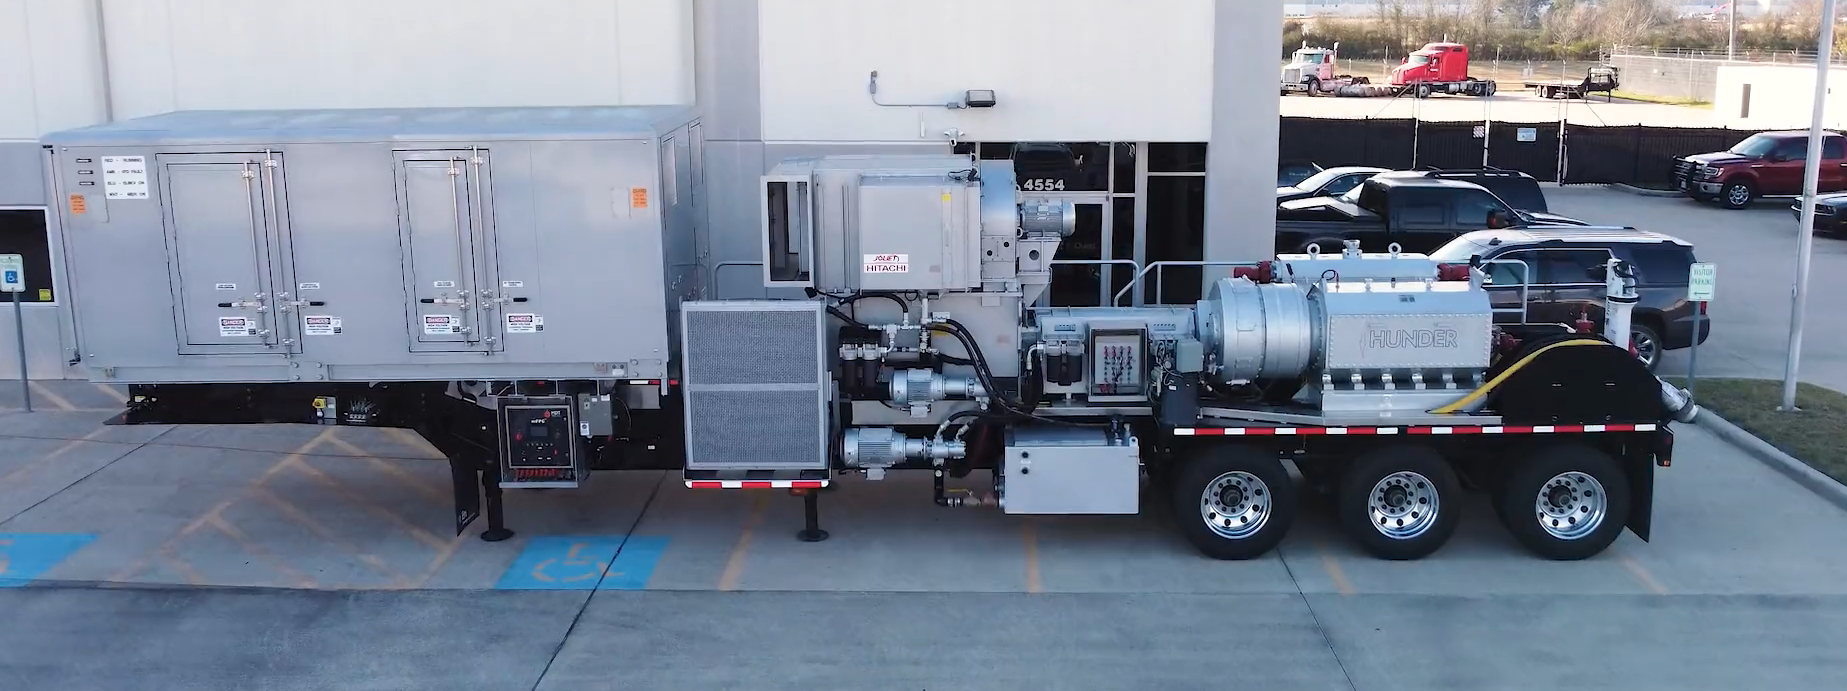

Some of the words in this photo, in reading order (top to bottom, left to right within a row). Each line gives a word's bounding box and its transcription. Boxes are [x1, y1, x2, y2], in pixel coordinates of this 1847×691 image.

[1023, 178, 1065, 191] 4554
[866, 264, 906, 272] HITACHI
[1693, 268, 1713, 276] VISITOR
